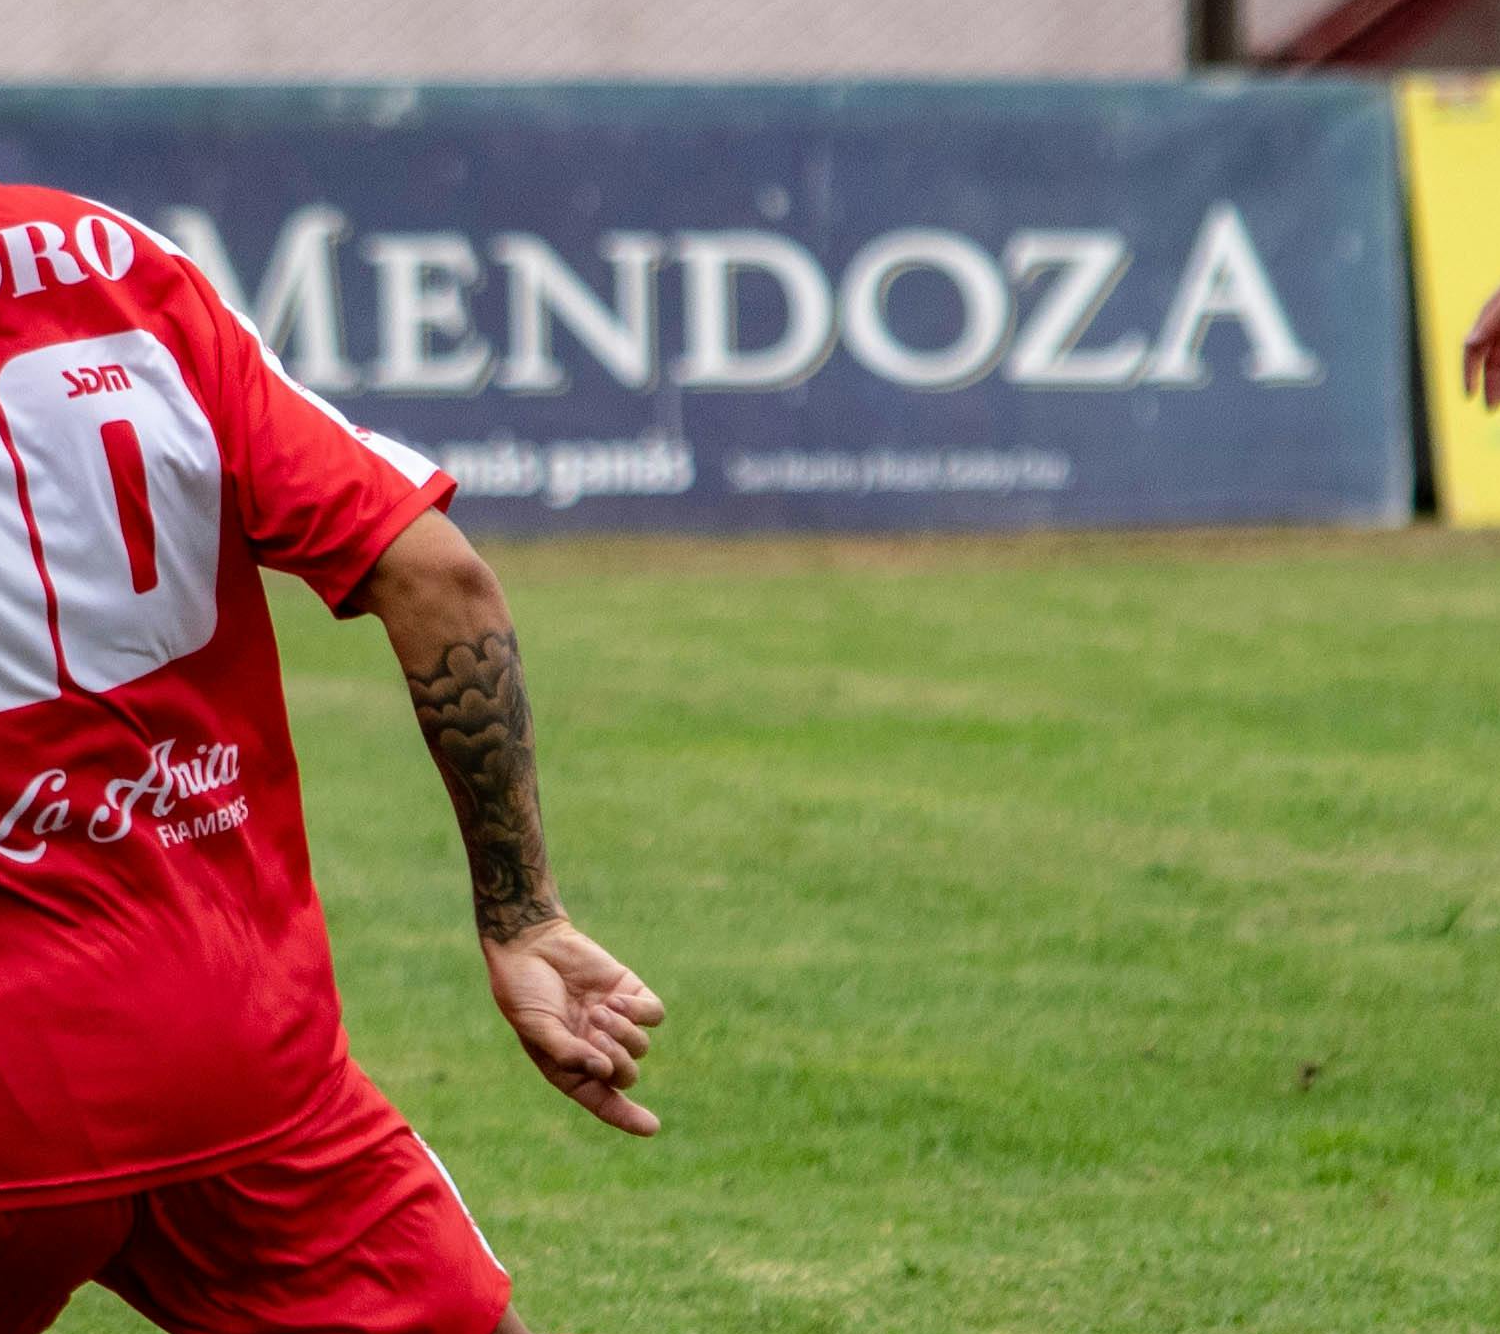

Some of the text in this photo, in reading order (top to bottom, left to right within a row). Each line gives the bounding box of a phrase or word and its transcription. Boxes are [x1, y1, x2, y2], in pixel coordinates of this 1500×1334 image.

[160, 200, 1322, 395] MENDOZA
[87, 738, 241, 843] Anita
[156, 795, 249, 849] FIAMBRS
